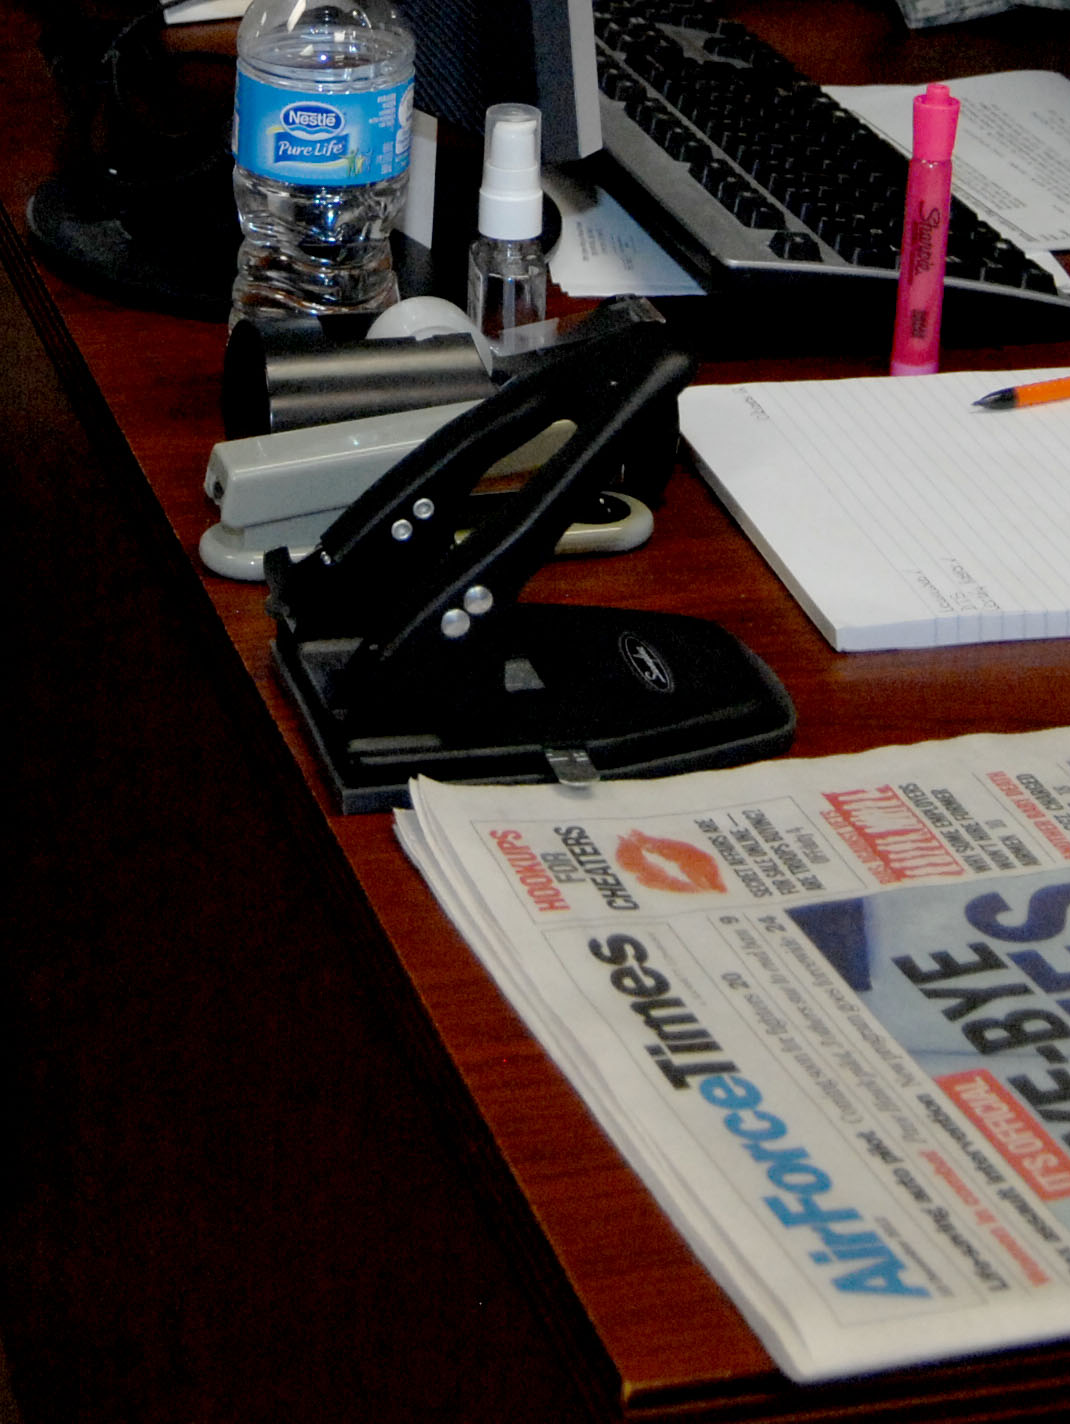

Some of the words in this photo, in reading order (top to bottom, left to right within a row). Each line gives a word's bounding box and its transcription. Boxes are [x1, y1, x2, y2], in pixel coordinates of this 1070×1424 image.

[278, 140, 313, 158] Pure
[314, 138, 345, 157] Life
[894, 782, 955, 828] EMPLOYERS
[927, 787, 975, 821] FORMER
[1012, 772, 1067, 812] CHARGED
[936, 827, 978, 853] SOME
[976, 841, 1020, 871] WON'T
[996, 834, 1043, 867] AIRMEN
[486, 829, 572, 913] HOOKUPS
[538, 850, 586, 884] FOR
[550, 823, 642, 912] CHEATERS
[752, 856, 787, 879] SALE
[767, 842, 812, 874] TROOPS
[958, 853, 995, 873] WHY
[715, 914, 742, 926] 9
[755, 914, 789, 934] 24
[719, 971, 751, 991] 20
[945, 1075, 1050, 1156] OFFICIAL
[854, 1130, 905, 1164] pilot
[914, 1093, 1007, 1185] intervention
[885, 1166, 934, 1205] auto
[916, 1147, 983, 1207] combat
[992, 1185, 1062, 1243] assault
[921, 1205, 1011, 1292] Life-saving
